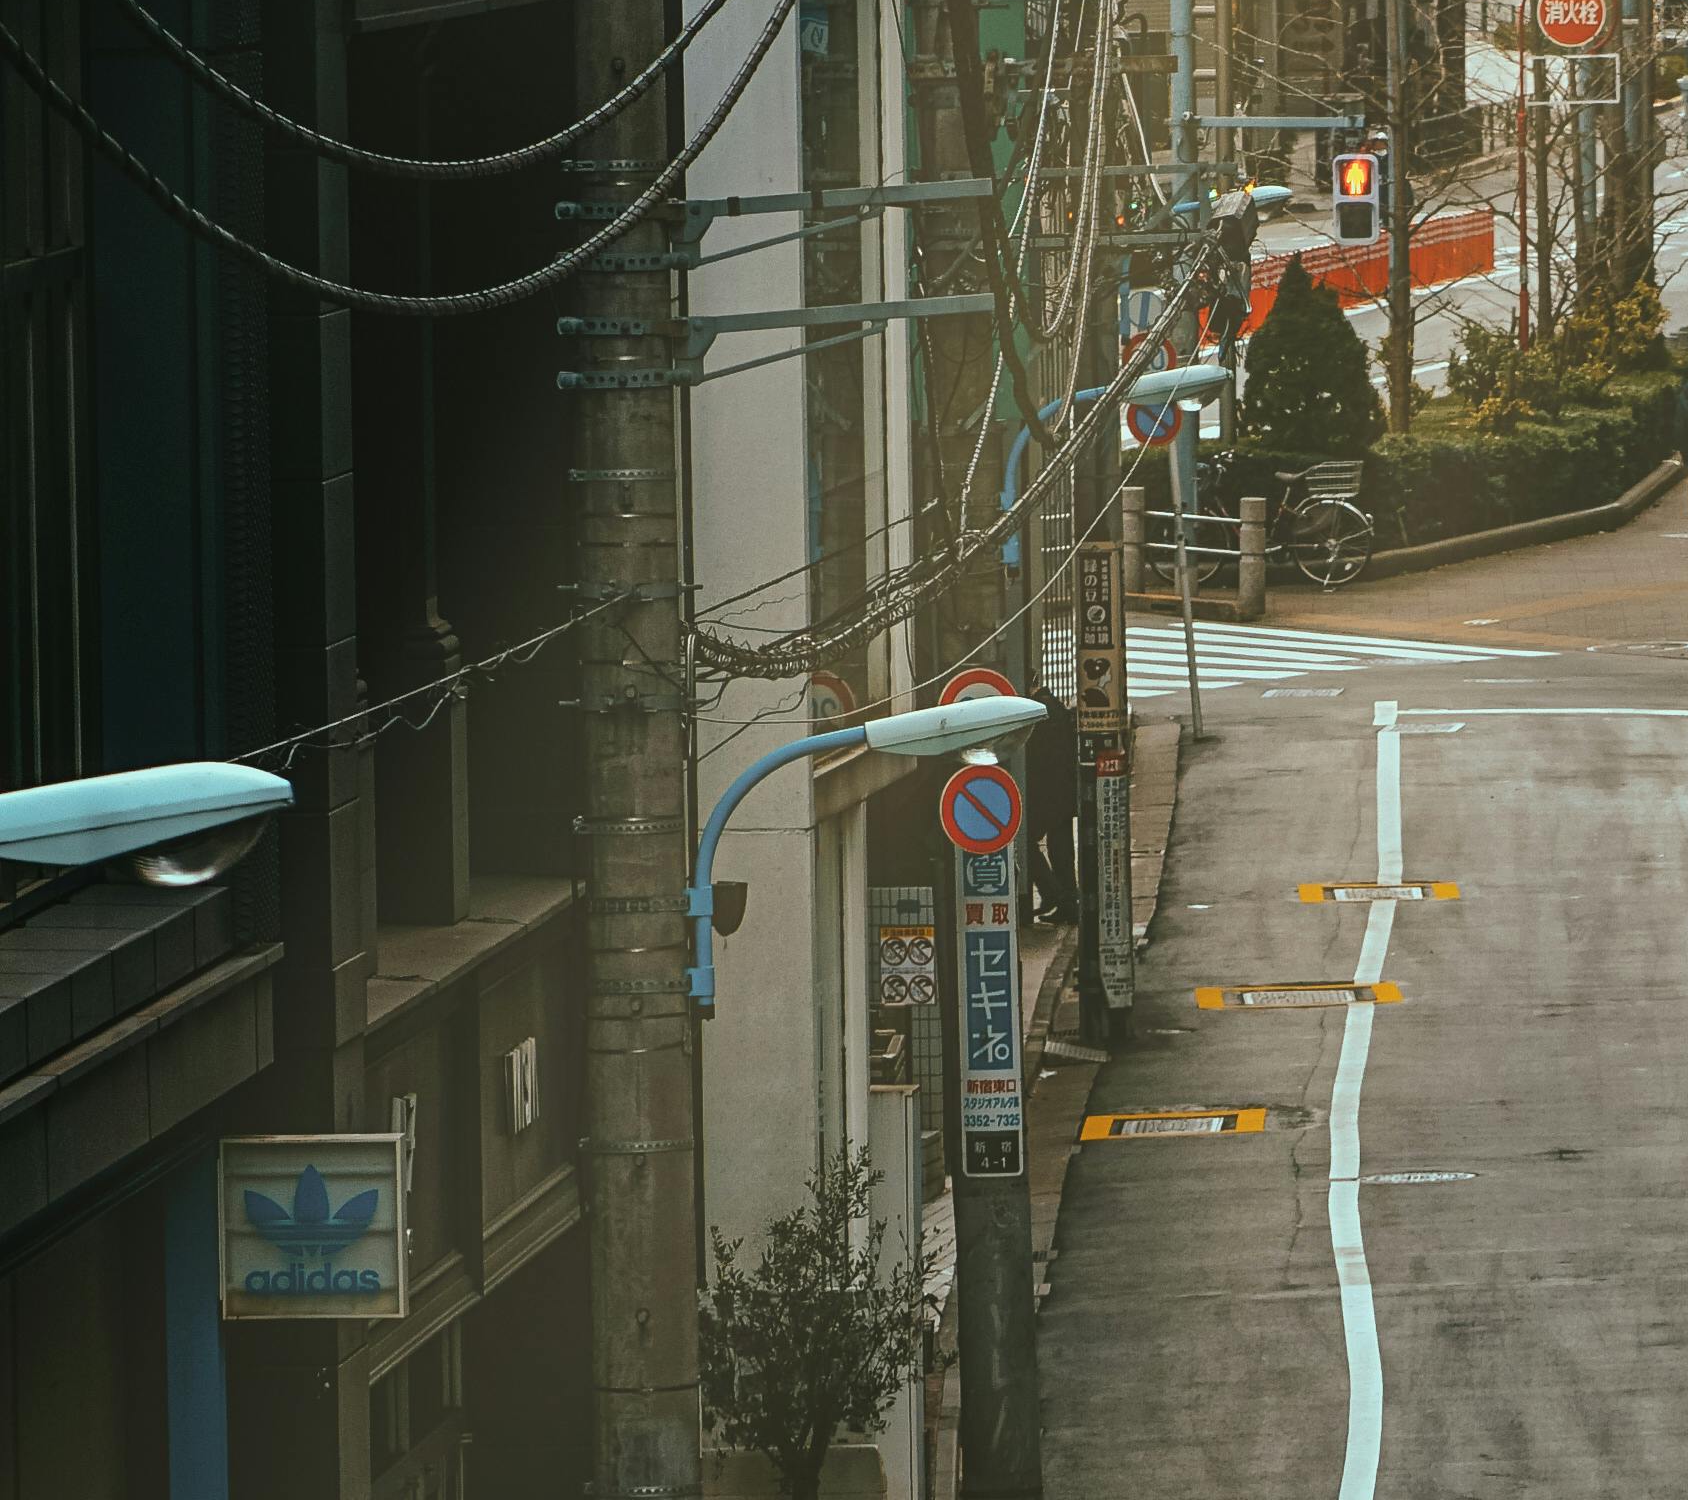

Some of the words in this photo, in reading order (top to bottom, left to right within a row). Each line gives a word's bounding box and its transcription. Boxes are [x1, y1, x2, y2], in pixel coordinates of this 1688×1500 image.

[1544, 0, 1600, 25] 消火栓
[965, 903, 1010, 926] 買取
[966, 1079, 1018, 1094] 新宿東口
[963, 1113, 1021, 1128] 3352-7325
[974, 1140, 1013, 1155] 新宿
[980, 1156, 1008, 1169] 4-1
[244, 1262, 381, 1294] adidas
